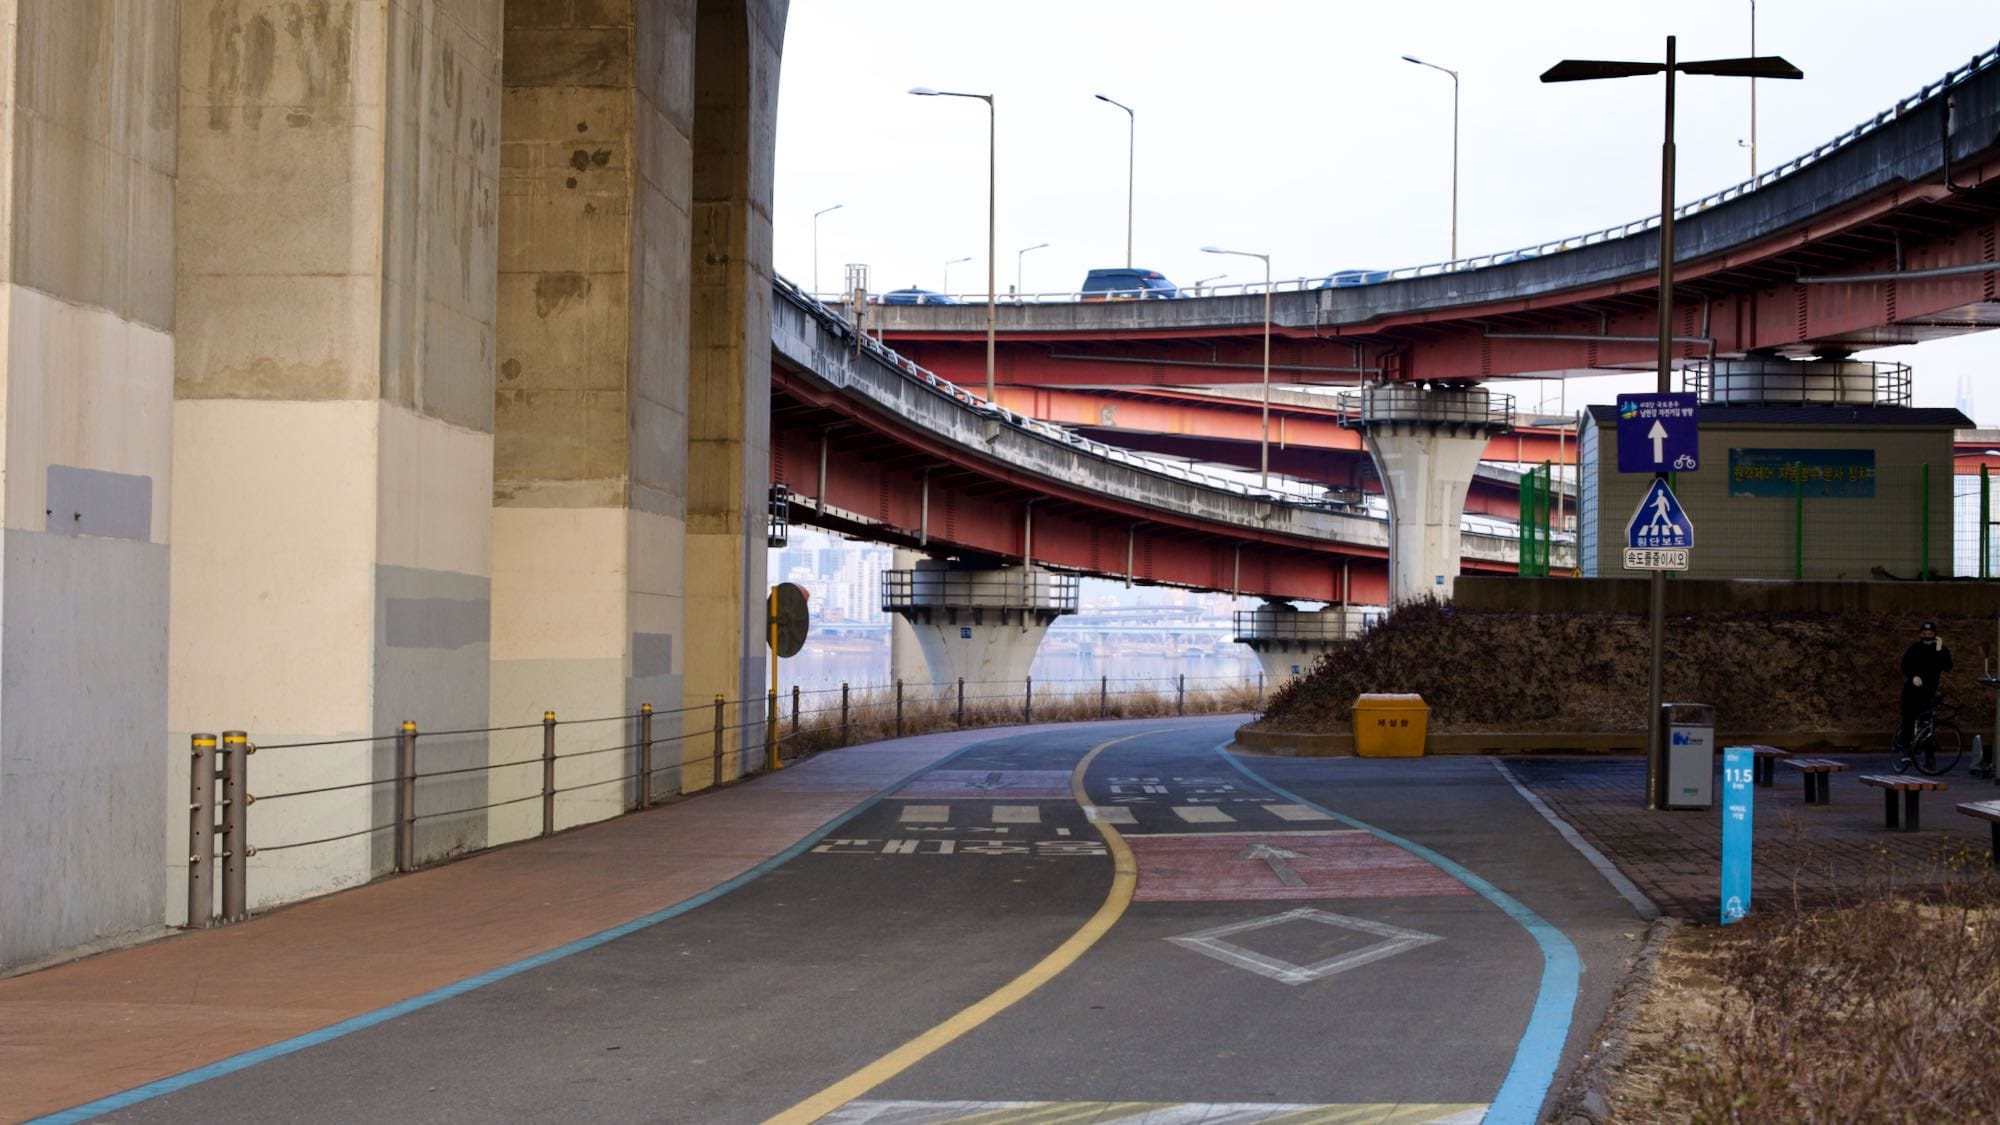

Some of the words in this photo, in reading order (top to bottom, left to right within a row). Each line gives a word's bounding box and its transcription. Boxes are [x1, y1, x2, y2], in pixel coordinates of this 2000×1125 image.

[1637, 536, 1685, 546] 횡단보도
[1725, 768, 1753, 783] 11.5
[1732, 782, 1745, 790] km
[808, 839, 1109, 856] 동호대교
